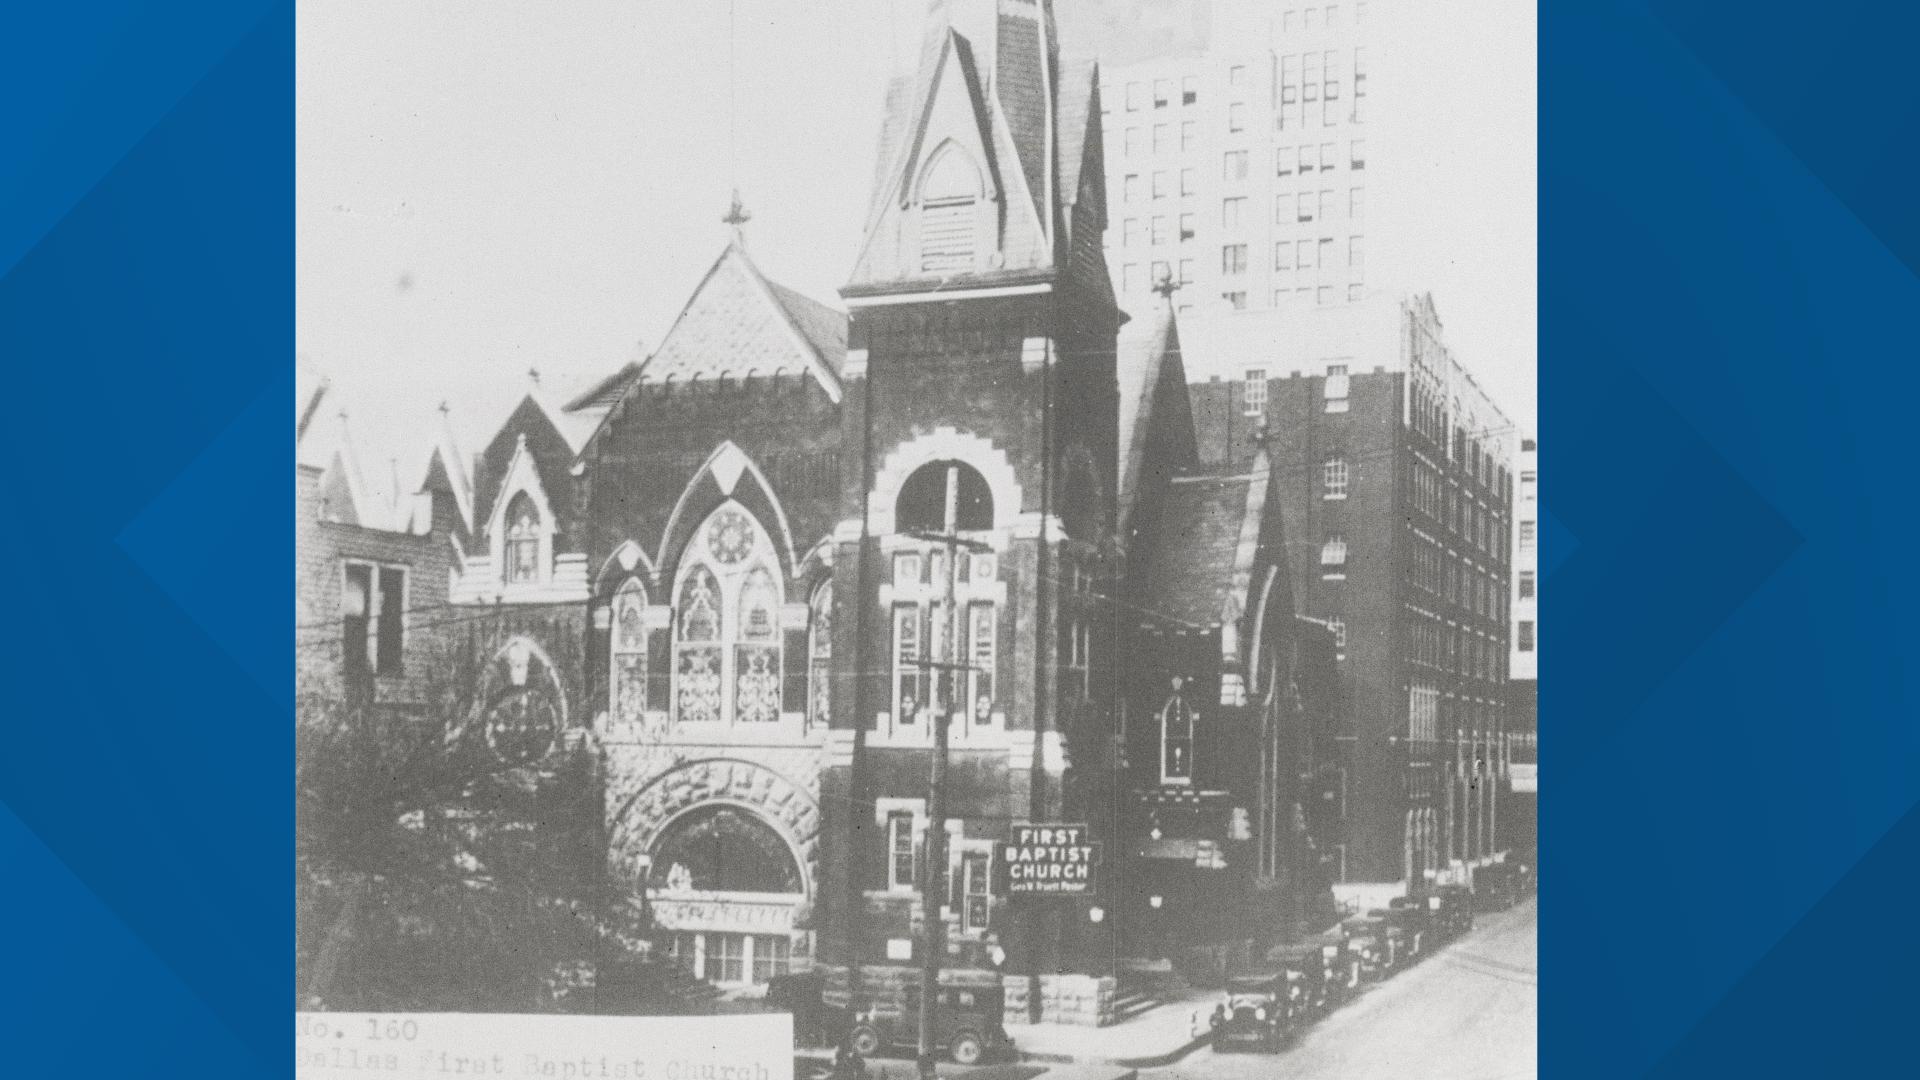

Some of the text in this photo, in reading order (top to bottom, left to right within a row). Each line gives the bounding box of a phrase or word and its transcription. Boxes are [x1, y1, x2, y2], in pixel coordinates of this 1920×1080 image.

[1021, 829, 1079, 845] FIRST
[1005, 846, 1092, 862] BAPTIST
[1010, 863, 1088, 879] CHURCH
